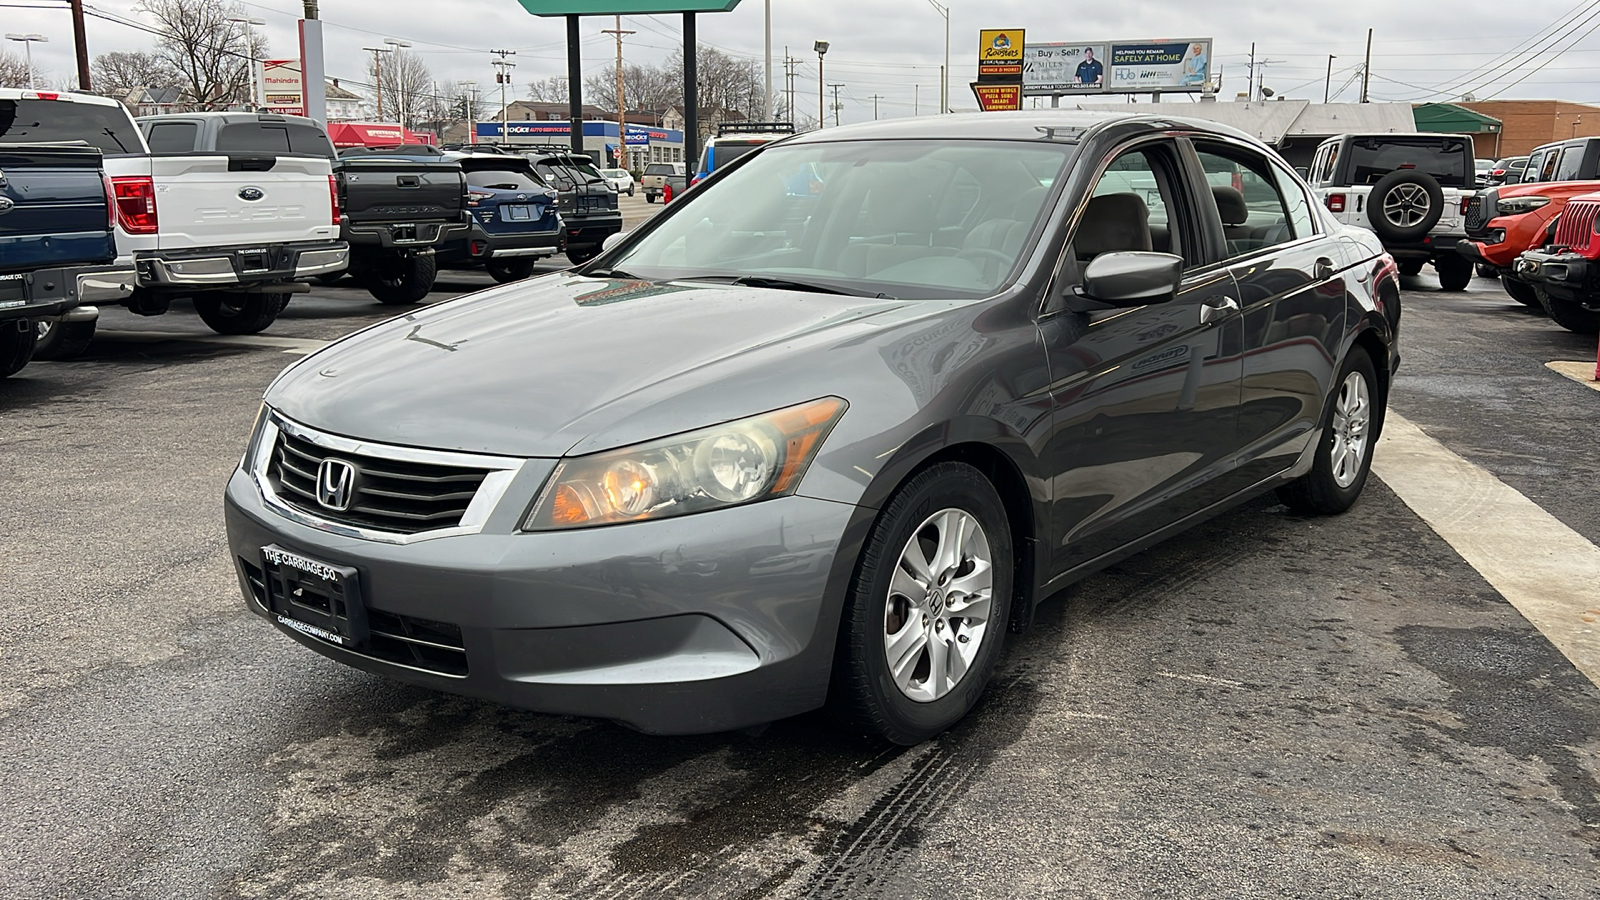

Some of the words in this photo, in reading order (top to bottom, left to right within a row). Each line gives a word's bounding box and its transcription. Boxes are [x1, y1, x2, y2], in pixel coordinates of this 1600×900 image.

[985, 48, 1018, 58] Roosters
[1038, 50, 1053, 58] Buy
[374, 206, 441, 214] TACOMA
[263, 549, 281, 562] THE
[282, 555, 323, 576] CARRIAGE
[322, 568, 338, 581] CO.
[277, 615, 343, 644] CARRIAGECOMPANY.COM
